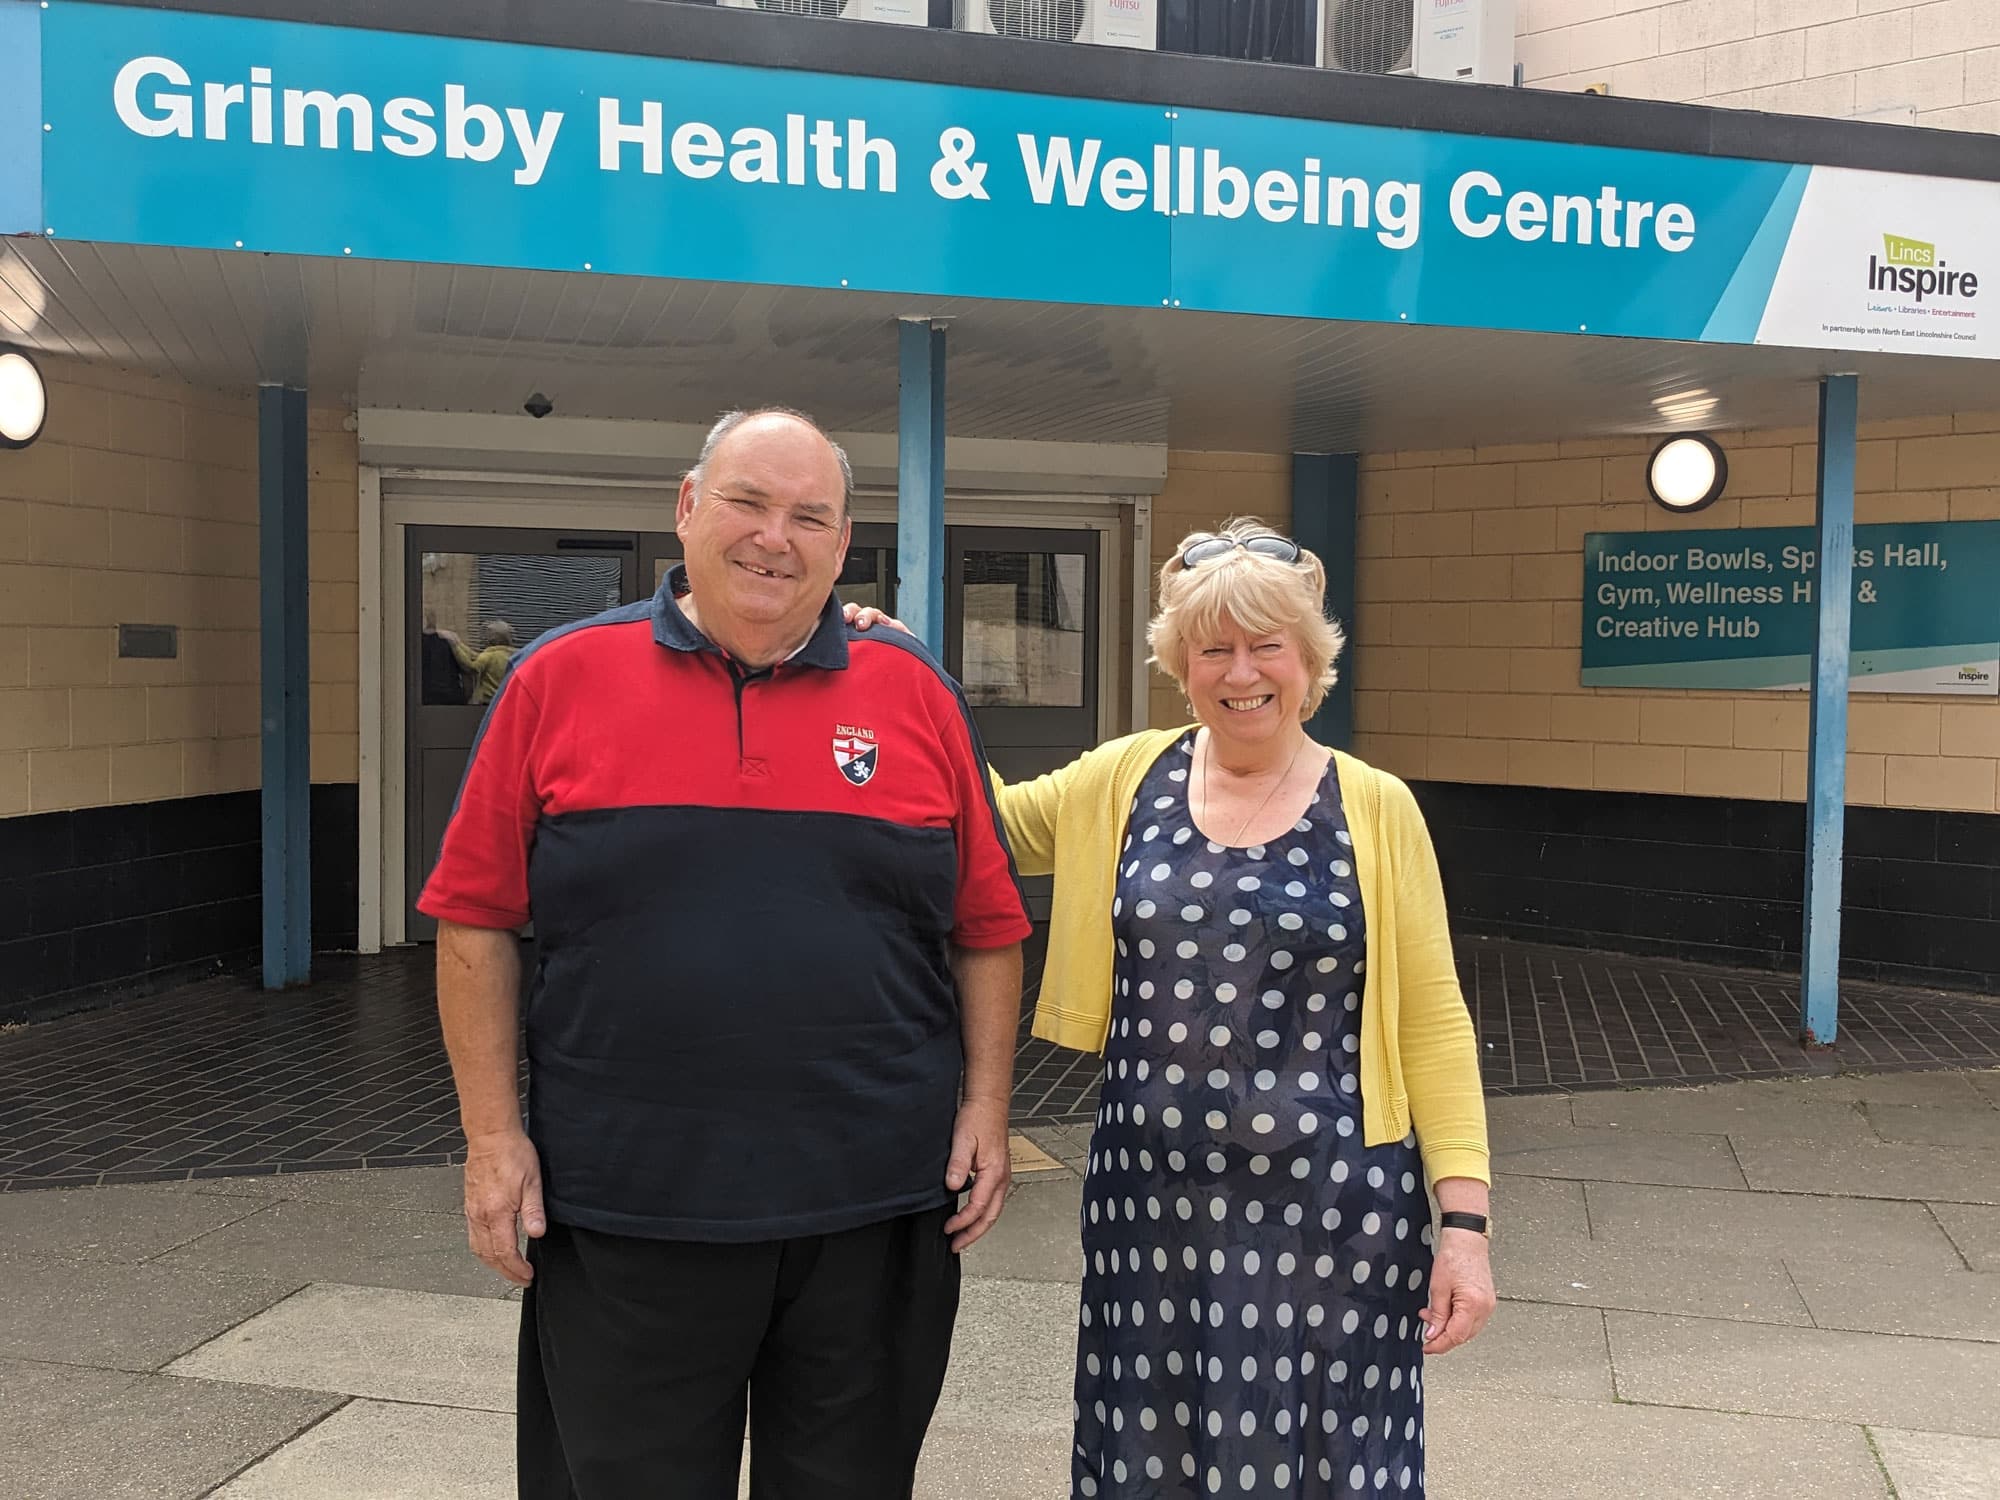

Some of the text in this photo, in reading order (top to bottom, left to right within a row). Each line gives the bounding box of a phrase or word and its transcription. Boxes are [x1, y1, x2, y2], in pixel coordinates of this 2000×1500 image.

[113, 55, 1696, 253] Grimsby Health & Wellbeing Centre
[1889, 241, 1931, 263] Lincs
[1868, 255, 1978, 302] Inspire
[1867, 302, 1976, 319] Leisure Libraries Entertainment
[1821, 323, 1828, 331] In
[1829, 325, 1866, 335] partnership
[1882, 328, 1901, 336] North
[1916, 330, 1953, 339] Lincolnshire
[1953, 333, 1976, 341] Council
[1598, 543, 1947, 574] Indoor Bowls, Spts Hall,
[1597, 583, 1661, 610] Gym,
[1666, 582, 1784, 604] Wellness
[1857, 580, 1877, 603] &
[1596, 616, 1761, 638] Creative Hub
[1958, 671, 1989, 682] Inspire
[836, 723, 874, 739] ENGLAND
